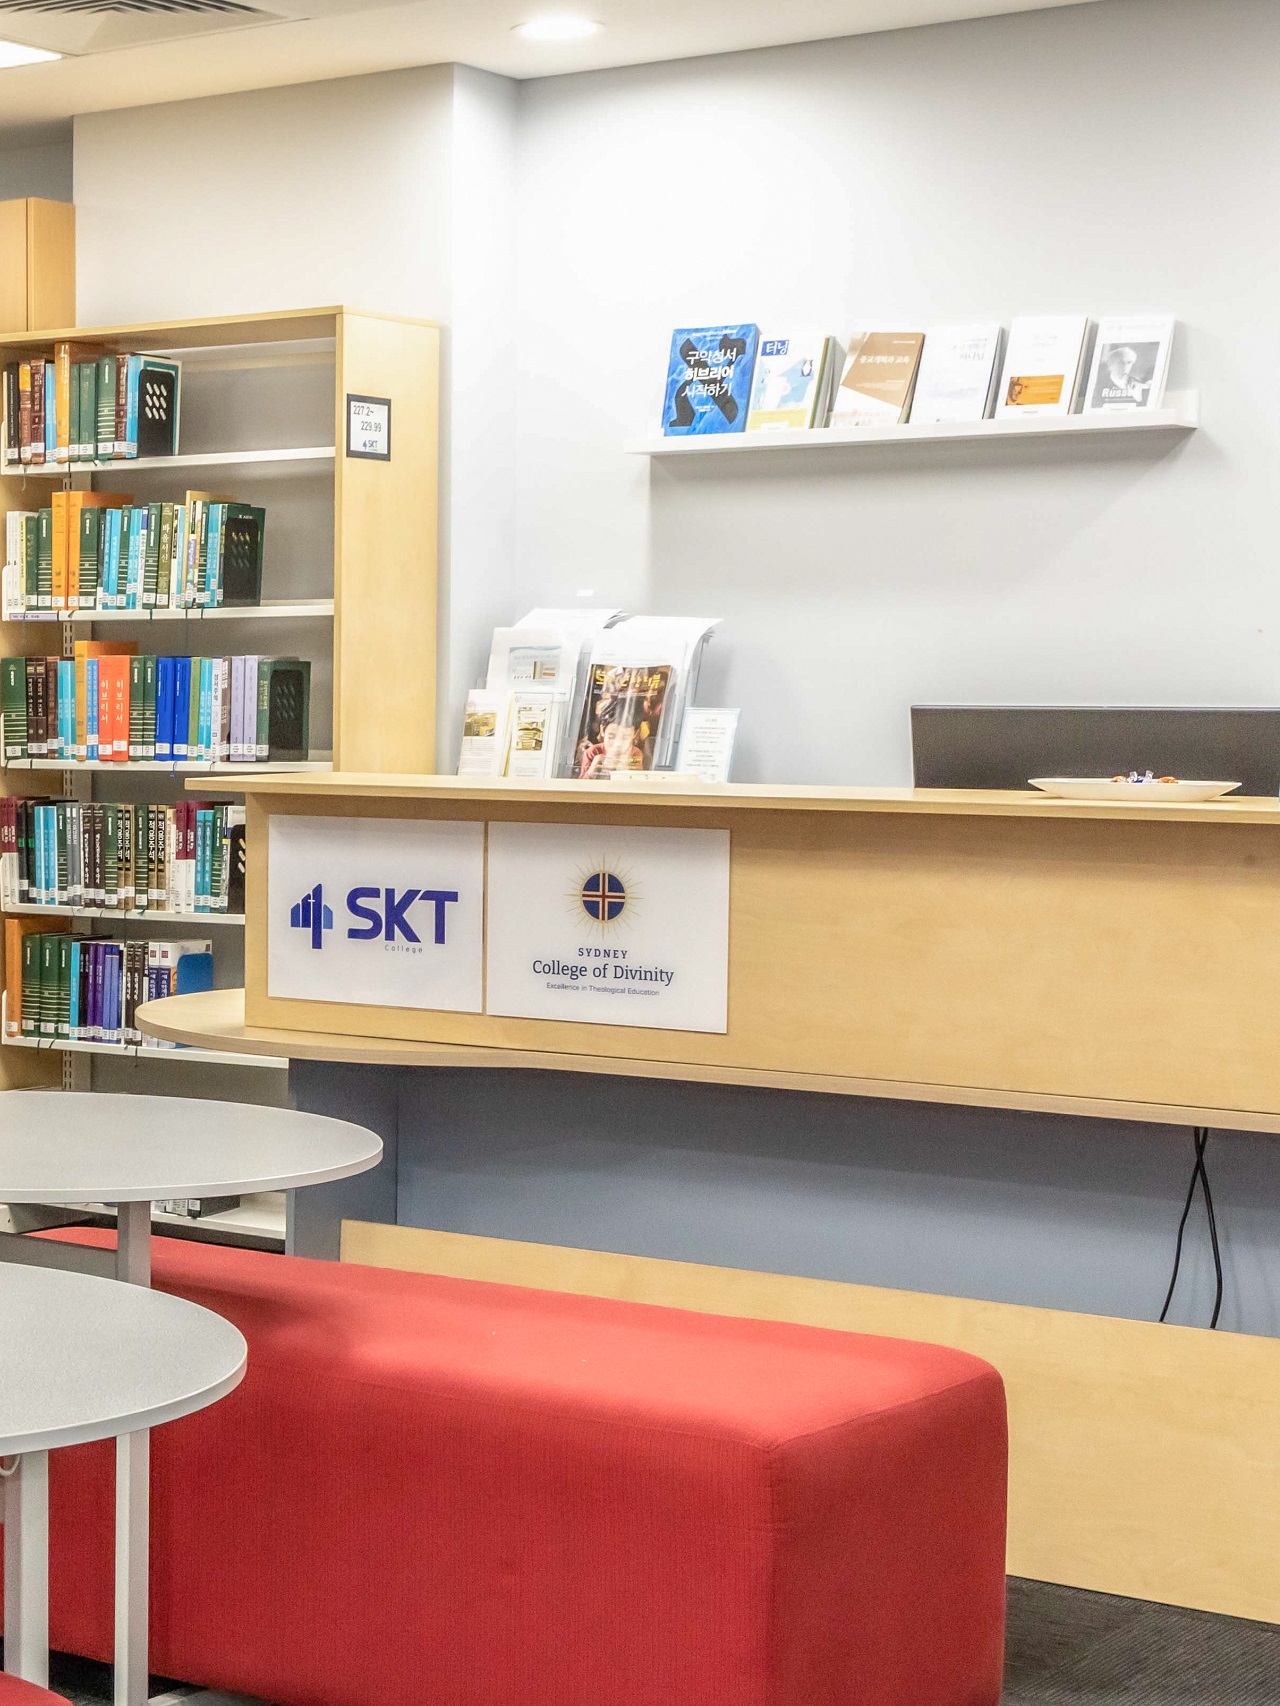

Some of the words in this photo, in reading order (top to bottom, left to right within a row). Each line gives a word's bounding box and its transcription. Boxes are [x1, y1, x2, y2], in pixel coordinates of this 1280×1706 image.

[765, 341, 789, 354] 터닝
[686, 348, 736, 364] 구약성서
[684, 365, 734, 381] 히브리어
[681, 382, 732, 398] 시작하기
[162, 522, 171, 562] 바울서신
[100, 680, 109, 724] 히브리서
[116, 680, 124, 724] 히브리서
[346, 886, 458, 944] SKT
[384, 944, 423, 954] College
[578, 948, 628, 959] SYDNEY
[532, 960, 588, 980] College
[592, 964, 608, 978] of
[614, 965, 674, 986] Divinity
[546, 982, 580, 991] Excellence
[589, 985, 626, 994] Theological
[628, 988, 660, 996] Education
